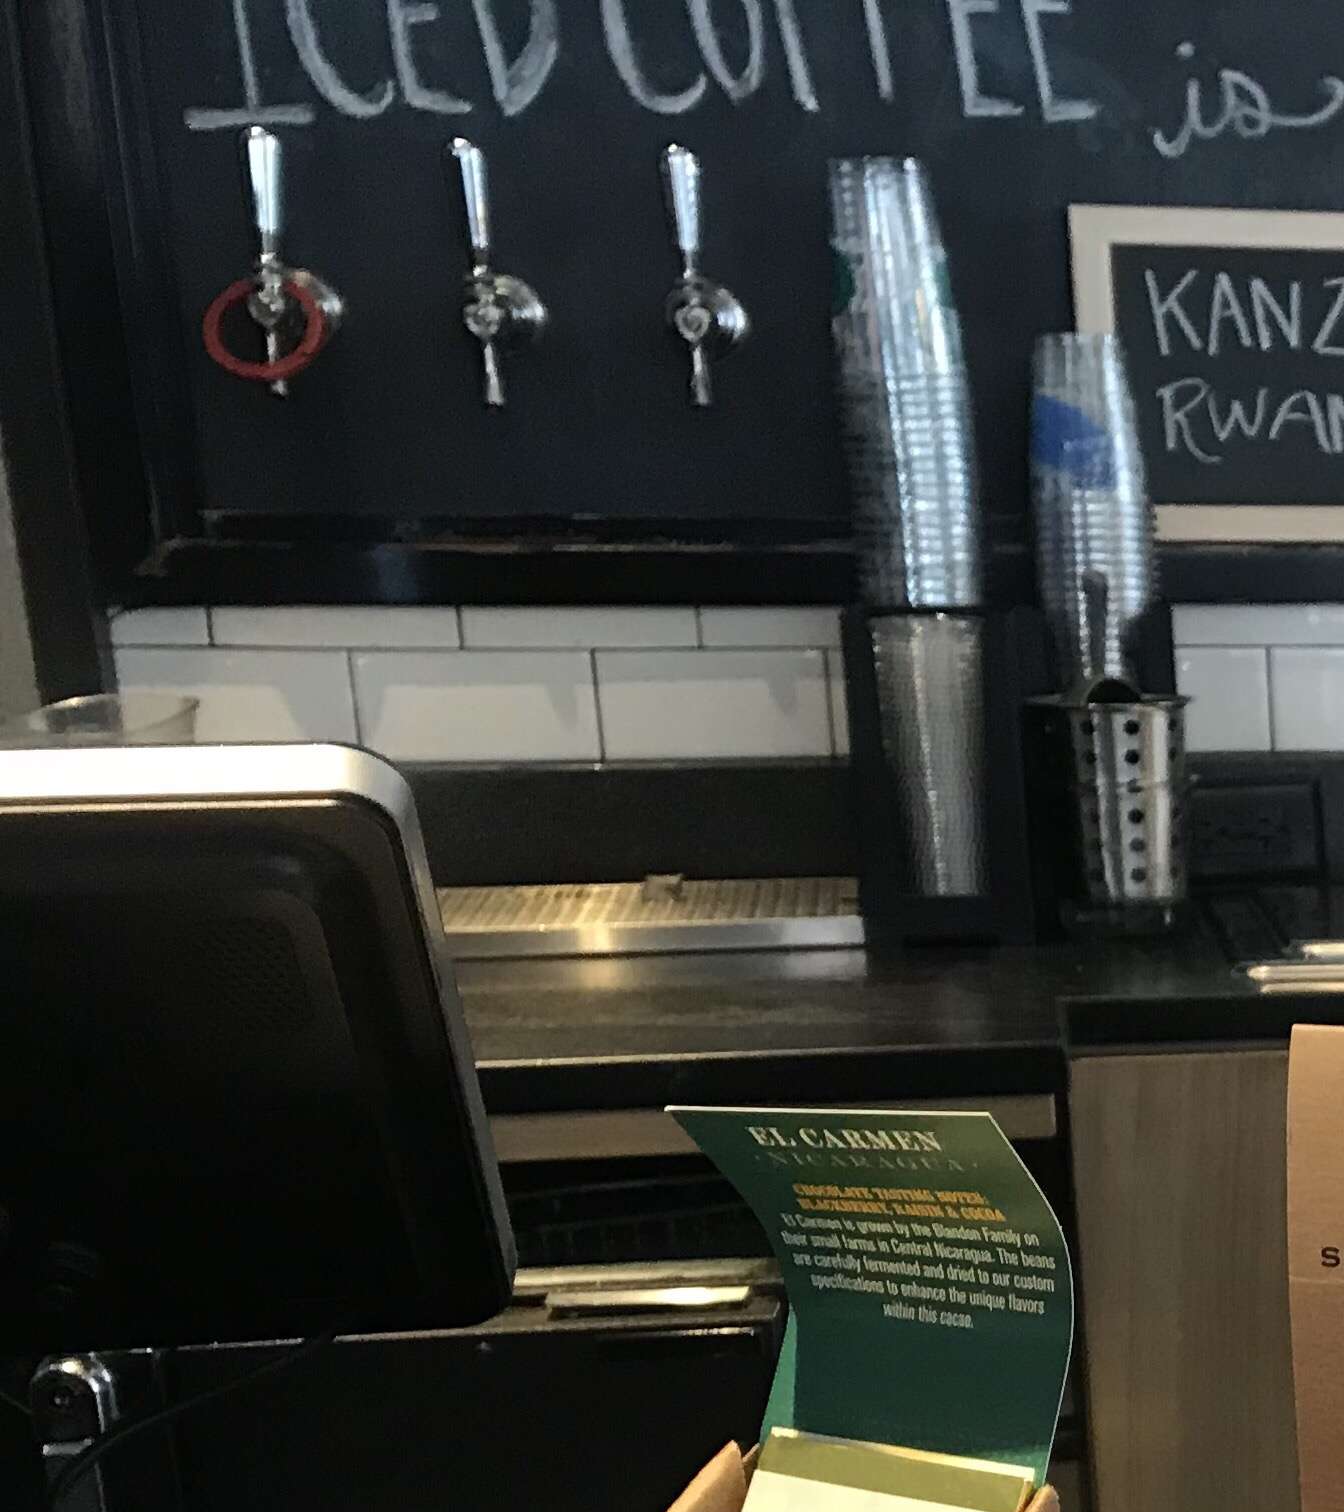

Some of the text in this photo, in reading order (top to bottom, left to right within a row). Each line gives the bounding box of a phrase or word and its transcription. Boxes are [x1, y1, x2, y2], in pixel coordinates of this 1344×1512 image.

[745, 1125, 943, 1152] EL CARMEN
[1023, 1233, 1040, 1247] on
[996, 1247, 1020, 1266] The
[1021, 1249, 1056, 1270] beans
[863, 1255, 921, 1277] fermented
[923, 1262, 945, 1280] and
[946, 1263, 976, 1284] dried
[992, 1271, 1011, 1288] our
[1013, 1272, 1056, 1293] custom
[901, 1281, 1046, 1316] enhance the unique flavors
[917, 1305, 938, 1325] this
